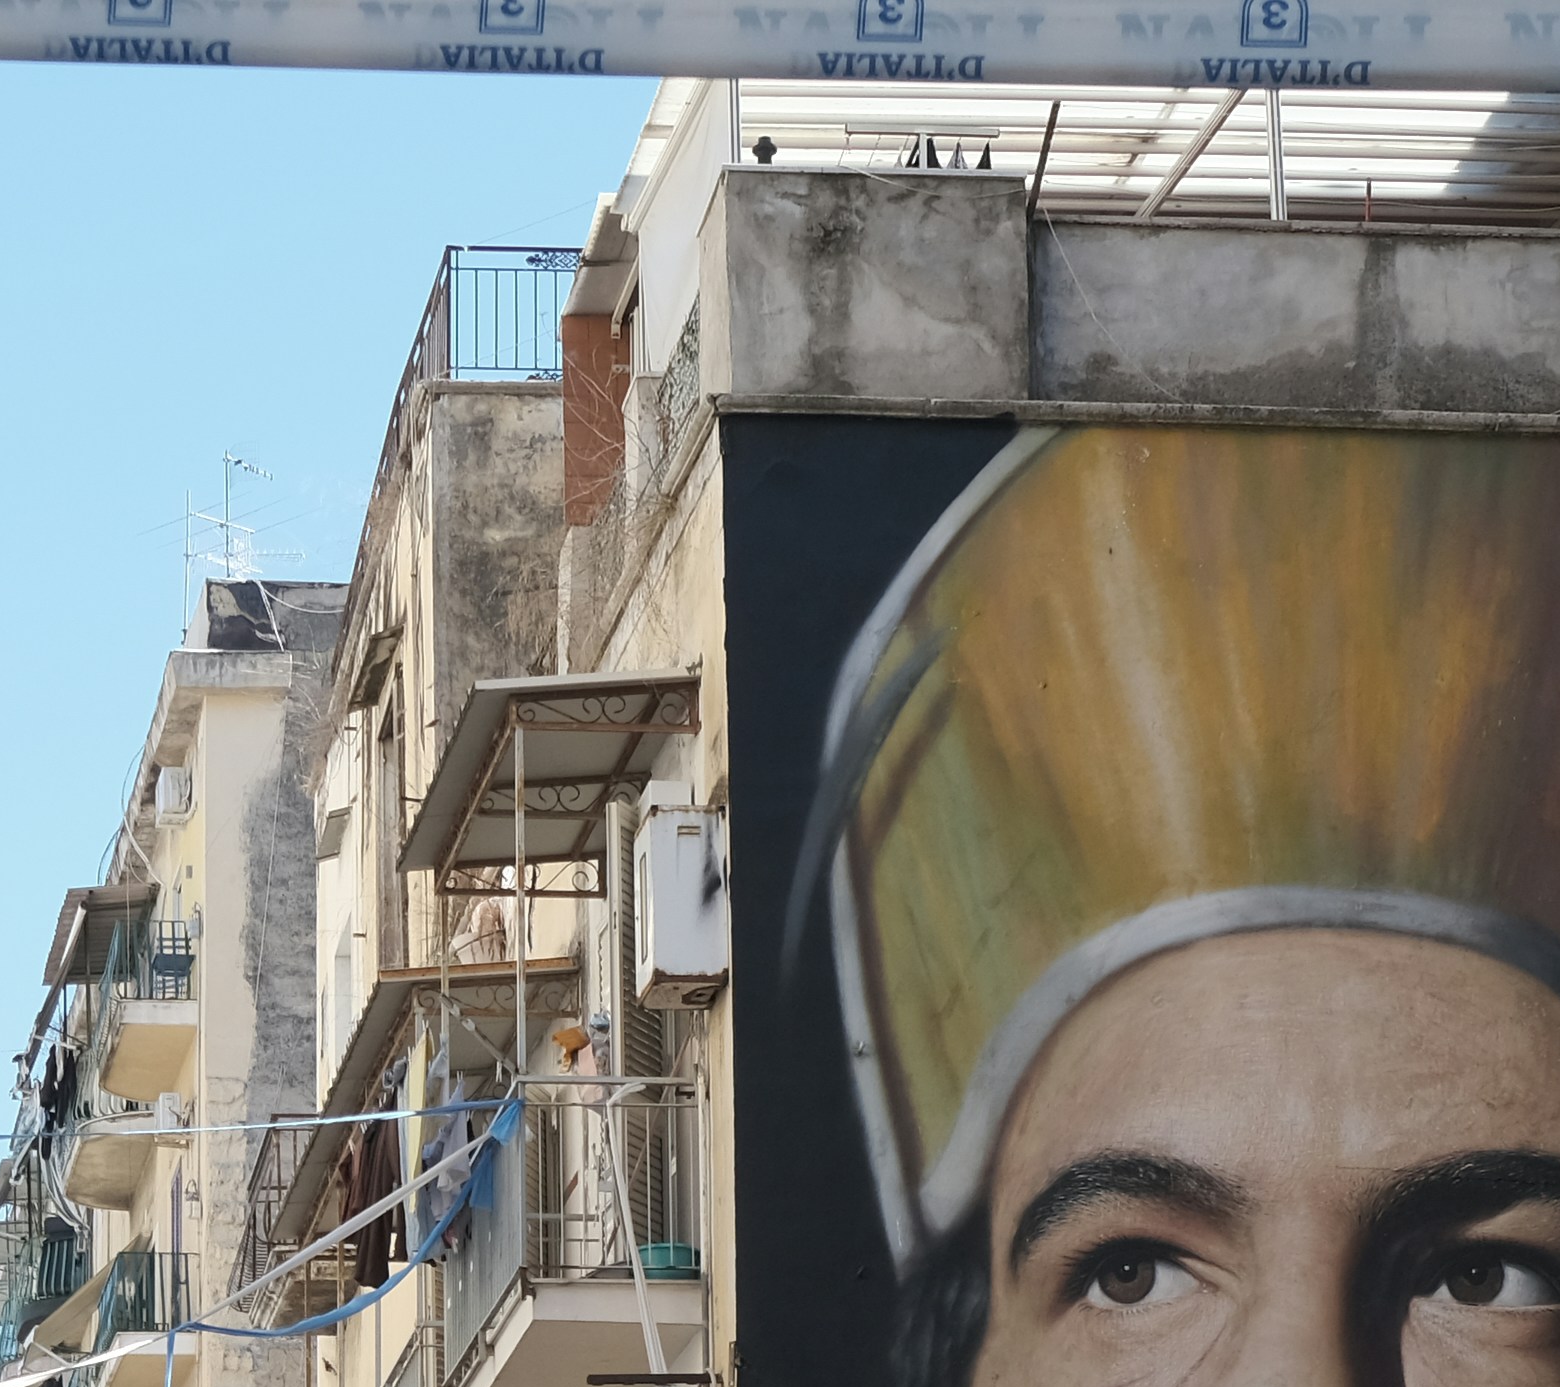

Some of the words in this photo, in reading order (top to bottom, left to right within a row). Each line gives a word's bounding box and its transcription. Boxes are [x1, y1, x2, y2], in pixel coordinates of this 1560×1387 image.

[68, 35, 231, 65] D'ITALIA
[439, 43, 606, 74] D'ITALIA
[817, 52, 985, 80] D'ITALIA
[1201, 58, 1372, 86] D'ITALIA
